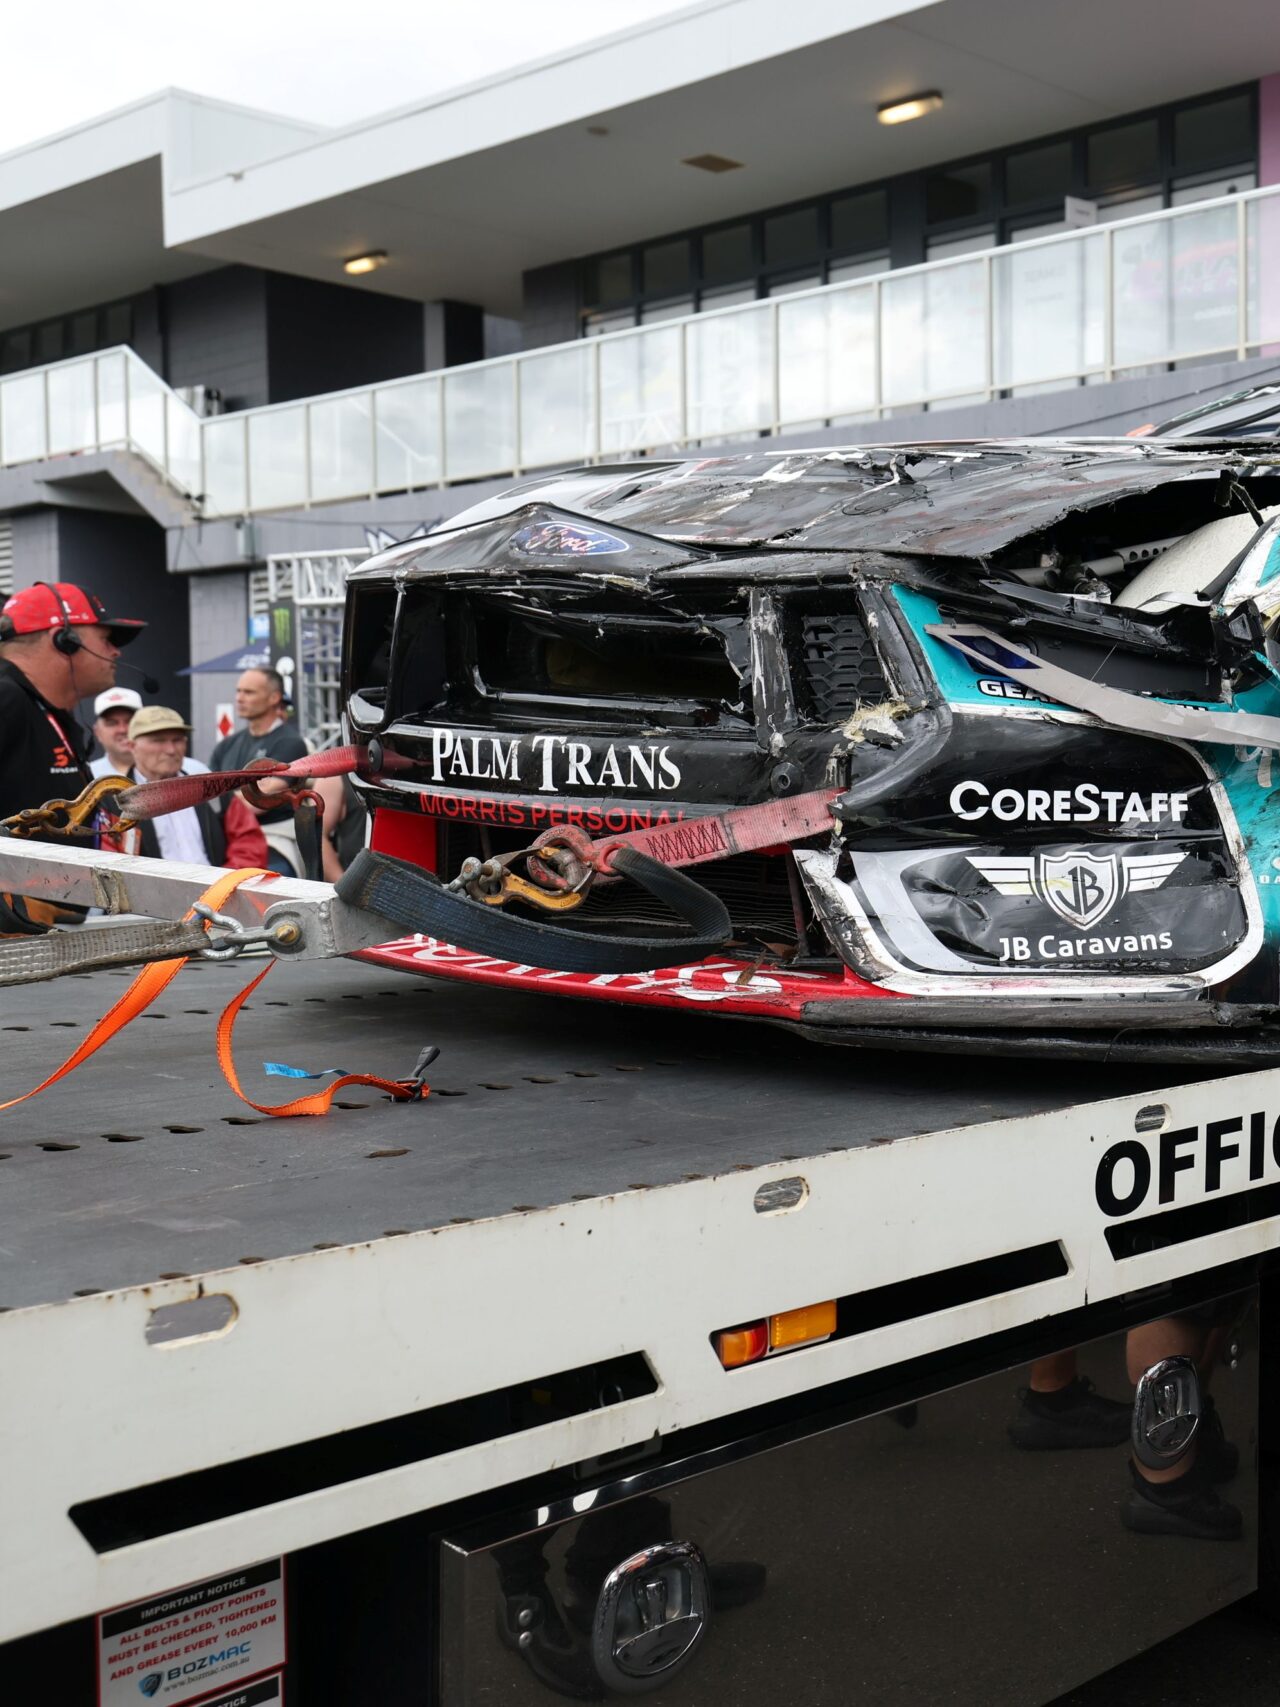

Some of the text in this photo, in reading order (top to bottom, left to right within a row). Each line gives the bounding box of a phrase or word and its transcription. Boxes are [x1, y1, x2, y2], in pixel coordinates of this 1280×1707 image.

[431, 728, 681, 791] PALM TRANS
[421, 790, 525, 824] MORRIS
[999, 932, 1173, 961] JB Caravans
[120, 1587, 266, 1646] ALL BOLTS & PIVOT POINTS
[140, 1576, 246, 1619] IMPORTANT NOTICE
[107, 1598, 277, 1665] MUST BE CHECKED, TIGHTENED
[110, 1613, 277, 1682] AND GREASE EVERY 10,000 KM
[166, 1640, 252, 1681] BOZMAC
